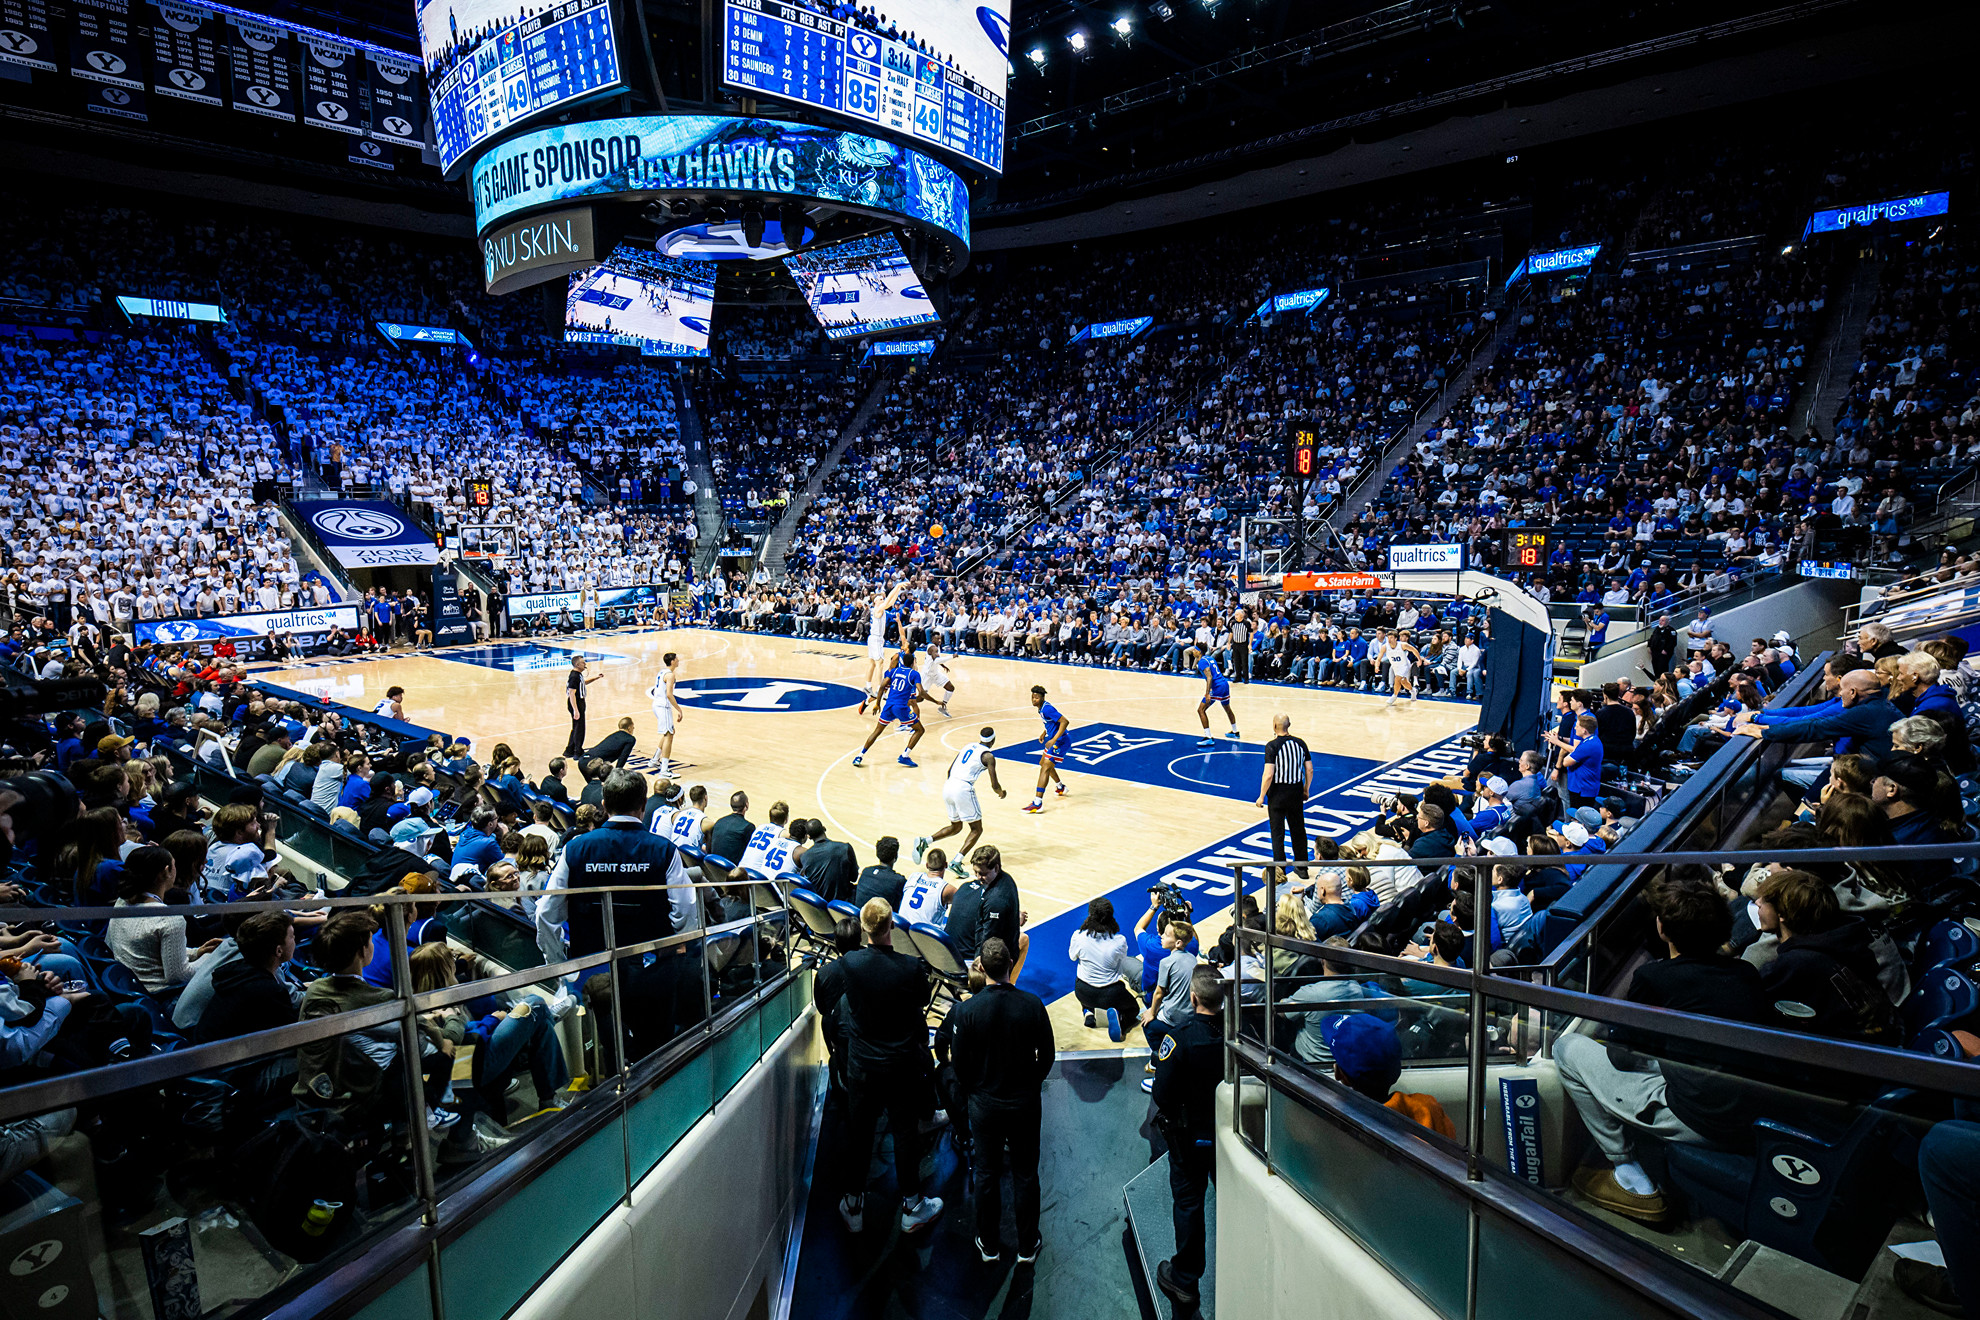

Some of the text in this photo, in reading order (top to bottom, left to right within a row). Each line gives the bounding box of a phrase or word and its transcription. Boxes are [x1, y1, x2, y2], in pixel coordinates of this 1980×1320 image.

[165, 10, 202, 25] NCAA
[522, 1, 579, 36] PLAYER PTS REB
[587, 13, 592, 25] 0
[600, 8, 606, 20] 0
[781, 7, 844, 37] PTS REB AST PF
[243, 29, 277, 44] NCAA
[589, 28, 595, 40] 0
[602, 24, 608, 35] 0
[734, 10, 841, 52] 0 MAG 13 2 0 0
[314, 47, 344, 61] NCAA
[564, 54, 569, 66] 2
[605, 39, 610, 51] 0
[730, 39, 740, 52] 13
[742, 42, 760, 57] KEITA
[785, 54, 790, 66] 8
[734, 25, 841, 66] 3 DEMIN 7 3 5 0
[479, 47, 495, 72] 3:14
[857, 60, 871, 74] BYU
[888, 47, 911, 72] 3:14
[381, 65, 409, 78] NCAA
[566, 69, 571, 81] 2
[730, 54, 840, 95] 15 SAUNDERS 22 2 3 3
[947, 69, 964, 86] PLAYER
[568, 69, 615, 95] 2 0 2
[728, 69, 739, 81] 30
[741, 72, 757, 86] HALL
[784, 83, 790, 95] 8
[820, 93, 825, 104] 7
[897, 75, 909, 88] HALF
[469, 104, 485, 137] 85
[508, 80, 528, 112] 49
[848, 79, 939, 135] 85 49
[883, 94, 887, 103] 3
[889, 97, 906, 109] TIMEOUTS
[892, 108, 903, 118] FOULS
[907, 113, 911, 122] 4
[628, 144, 795, 192] JAYHAWKS
[492, 152, 531, 203] GAME
[838, 169, 858, 186] KU
[494, 231, 516, 271] NU
[1535, 252, 1583, 272] qualtrics
[1279, 294, 1315, 310] qualtrics
[1103, 321, 1134, 337] qualtrics
[886, 343, 919, 353] qualtrics
[1299, 449, 1311, 474] 18
[476, 491, 488, 505] 18
[1516, 534, 1545, 547] 3:14
[351, 548, 423, 557] ZIONS
[359, 555, 433, 564] BANK
[1521, 548, 1537, 566] 18
[1804, 568, 1813, 576] 85
[892, 679, 906, 692] 40
[961, 749, 973, 764] 0
[652, 815, 662, 834] 1
[674, 816, 695, 838] 21
[749, 831, 775, 851] 25
[585, 863, 650, 873] EVENT STAFF
[765, 848, 788, 871] 45
[909, 887, 929, 910] 5
[1502, 1082, 1512, 1127] INSEPARABLE
[1519, 1116, 1541, 1184] ougarTail
[1779, 1203, 1787, 1212] 4
